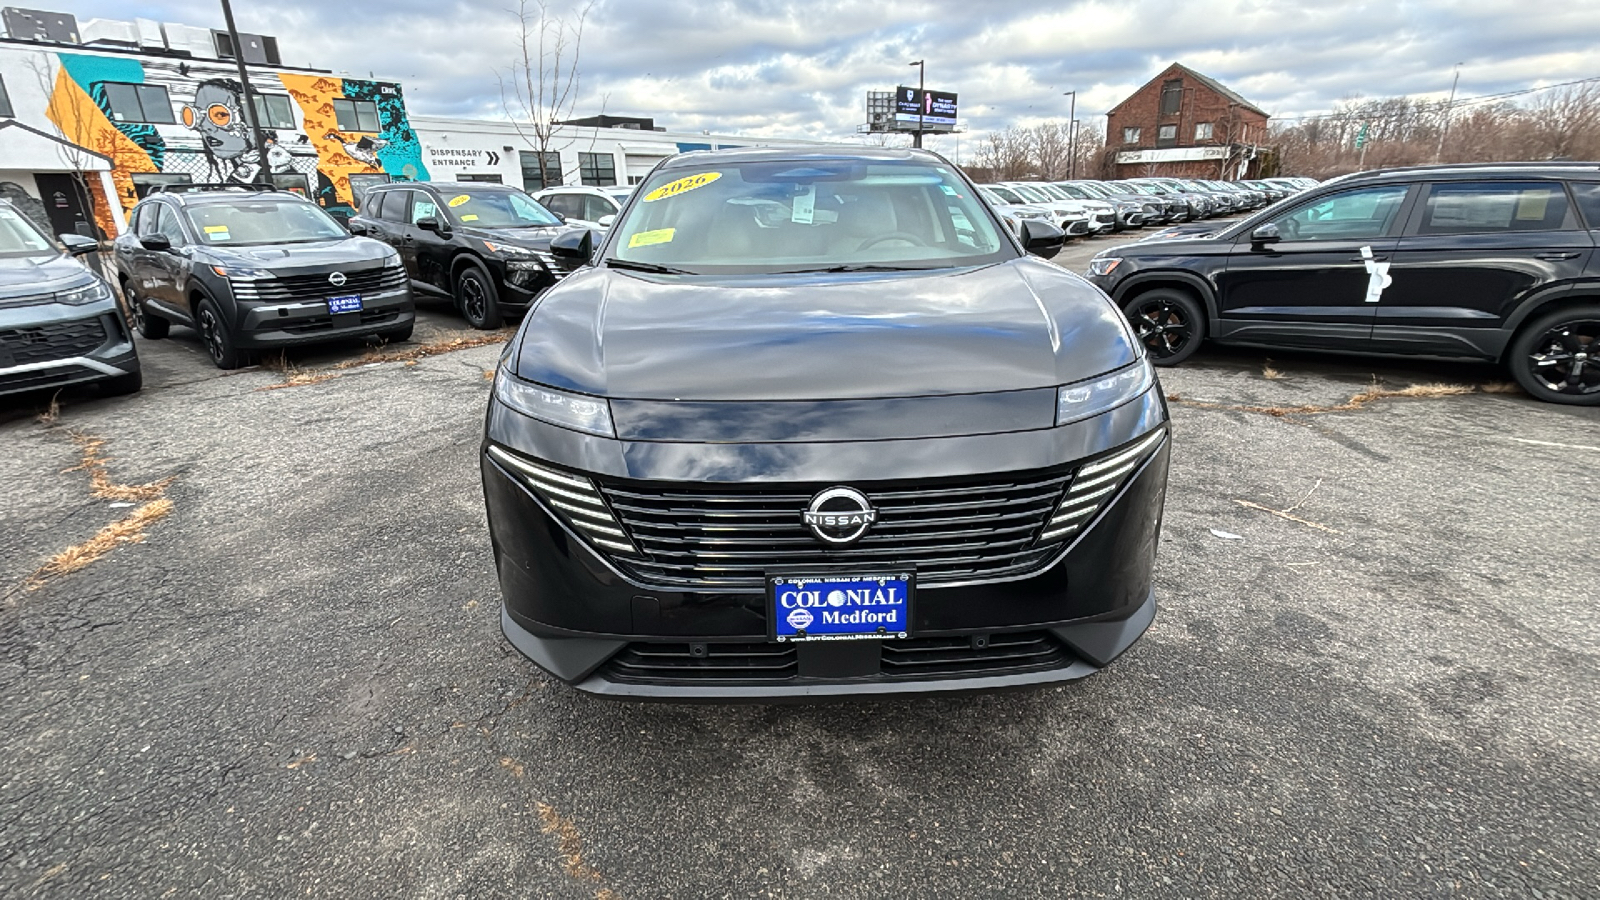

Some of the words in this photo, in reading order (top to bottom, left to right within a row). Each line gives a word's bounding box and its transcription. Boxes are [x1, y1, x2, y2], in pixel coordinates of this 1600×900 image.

[430, 149, 482, 157] DISPENSARY
[658, 175, 706, 198] 2026
[805, 512, 875, 526] NISSAN
[781, 588, 902, 608] COLONIAL
[822, 609, 897, 624] Medford
